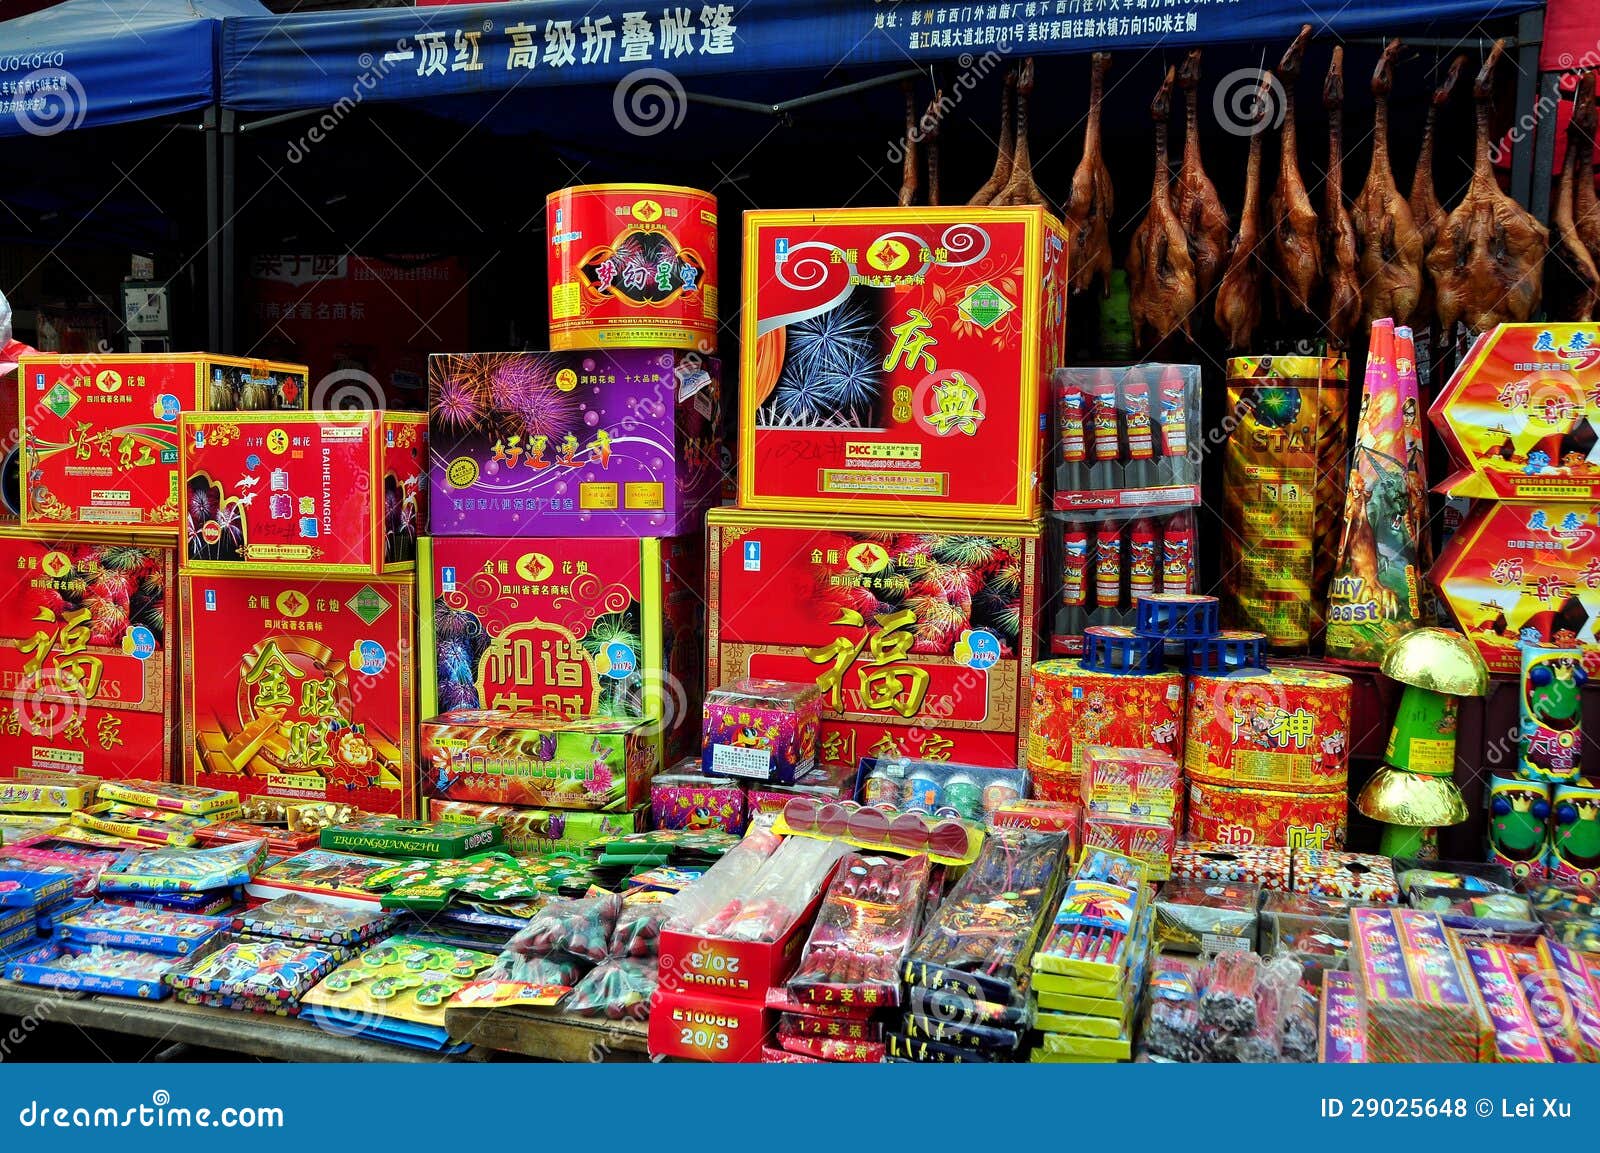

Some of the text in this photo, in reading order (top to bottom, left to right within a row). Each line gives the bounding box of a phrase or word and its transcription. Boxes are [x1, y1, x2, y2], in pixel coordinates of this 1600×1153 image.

[384, 4, 738, 76] 一顶红 高级折叠帐篷
[829, 247, 949, 264] 金雁 花炮
[596, 260, 698, 292] 梦幻星空
[850, 274, 926, 287] 四川省著名商标
[322, 448, 332, 535] BAIHELIANGCHI
[483, 560, 588, 574] 金雁 花炮
[810, 549, 927, 568] 金雁 花炮
[502, 584, 569, 596] 四川省著名商标
[247, 595, 340, 613] 金雁 花炮
[14, 605, 103, 700] 福
[490, 638, 584, 687] 和谐
[802, 607, 929, 718] 福
[691, 953, 740, 972] 20/3
[672, 1007, 739, 1029] E1008B
[680, 1028, 729, 1050] 20/3
